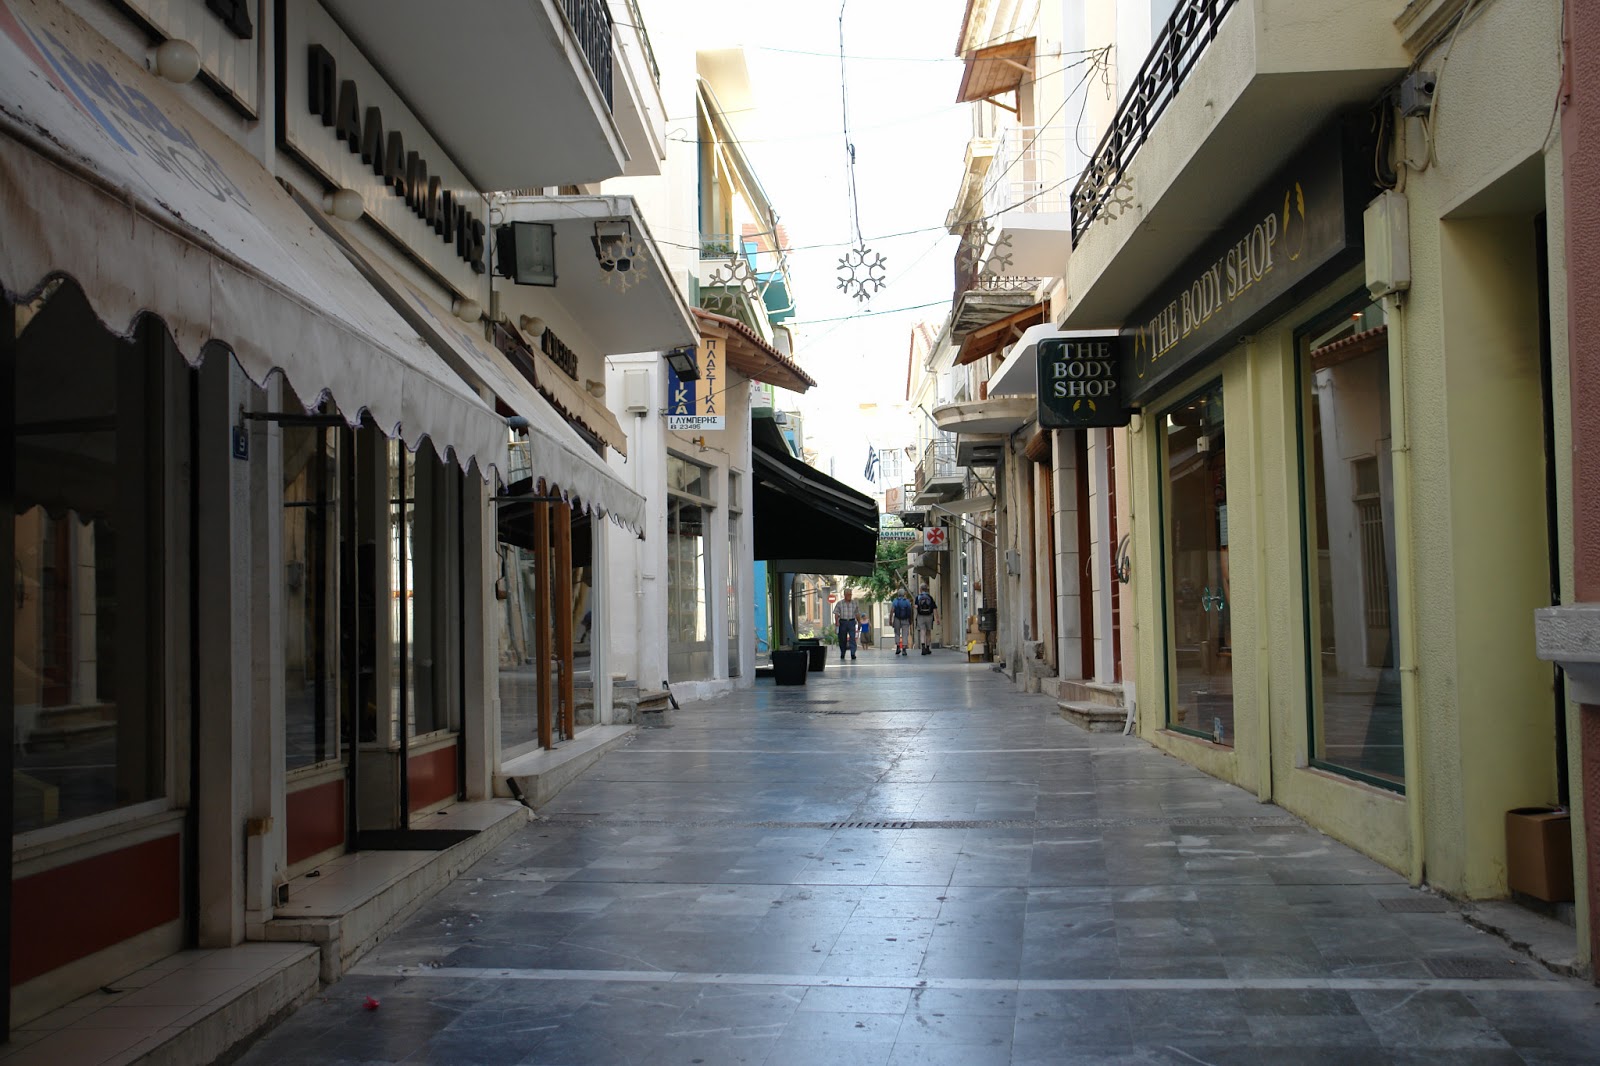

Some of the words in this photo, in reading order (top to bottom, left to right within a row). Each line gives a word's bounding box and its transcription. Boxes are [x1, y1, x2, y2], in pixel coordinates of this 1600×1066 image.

[1149, 300, 1180, 363] THE
[1180, 259, 1224, 339] BODY
[1226, 212, 1278, 303] SHOP
[1057, 342, 1111, 360] THE
[705, 340, 717, 414] ΠΛΑΣΤΙΚΑ
[1053, 360, 1116, 379] BODY
[1053, 380, 1117, 398] SHOP
[675, 416, 718, 424] ΛΥΜΠΕΡΗΣ
[239, 436, 246, 452] 9
